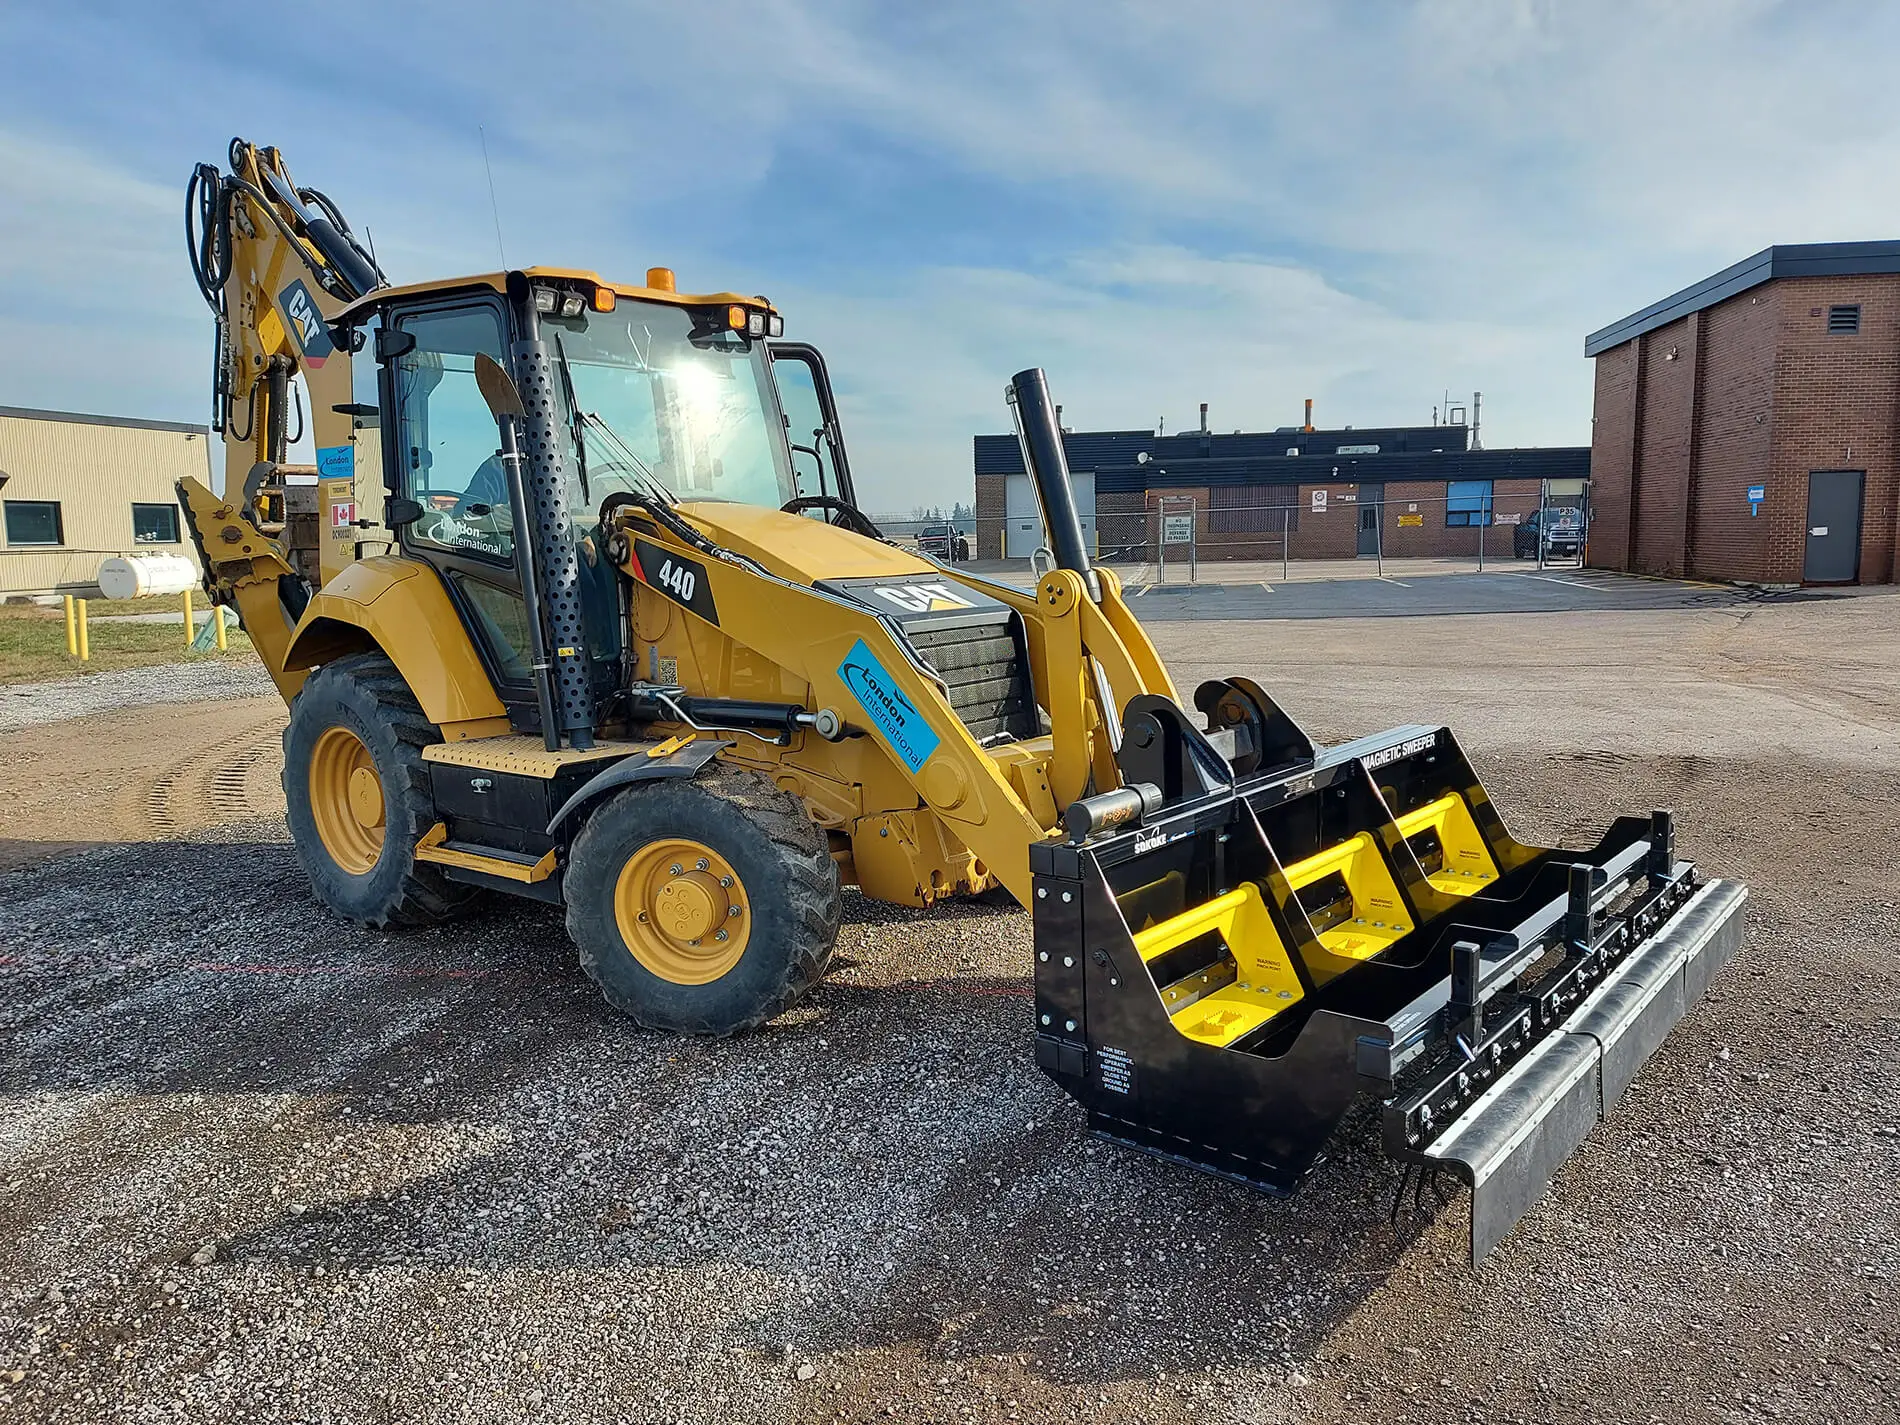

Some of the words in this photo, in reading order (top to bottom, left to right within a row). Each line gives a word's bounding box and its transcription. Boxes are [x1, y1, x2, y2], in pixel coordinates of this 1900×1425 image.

[289, 288, 320, 348] CAT
[325, 455, 349, 465] London
[447, 535, 502, 555] International
[658, 559, 695, 601] 440
[873, 584, 979, 613] CAT
[861, 667, 906, 728] London
[862, 688, 923, 767] International
[1360, 743, 1402, 770] MAGNETIC
[1402, 733, 1436, 757] SWEEPER
[1256, 958, 1281, 967] WARNING
[1113, 1048, 1127, 1056] BEST
[1100, 1063, 1123, 1074] SWEEPER
[1103, 1058, 1127, 1069] OPERATE
[1103, 1070, 1120, 1080] CLOSE
[1101, 1076, 1122, 1086] GROUND
[1104, 1083, 1128, 1094] POSSIBLE
